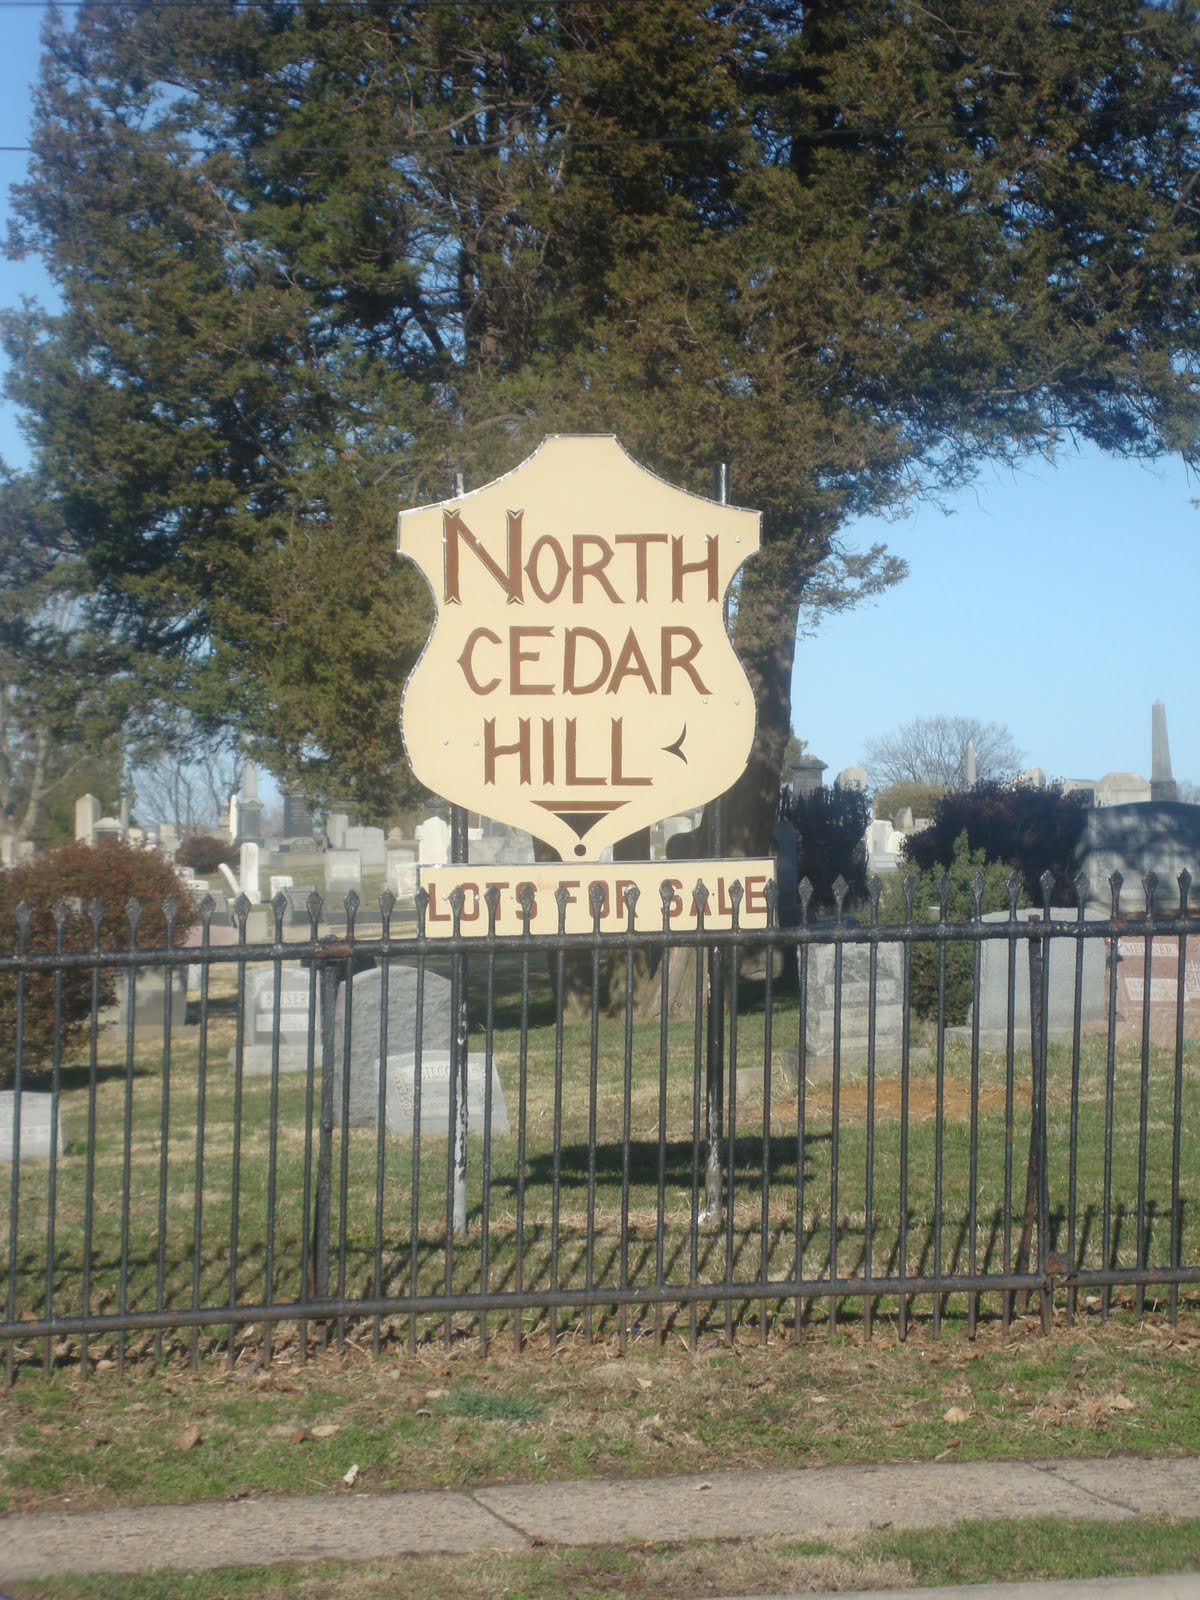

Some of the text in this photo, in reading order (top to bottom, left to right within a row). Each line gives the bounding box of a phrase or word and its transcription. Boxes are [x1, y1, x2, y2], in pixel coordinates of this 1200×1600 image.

[442, 508, 719, 606] NORTH
[456, 625, 713, 696] CEDAR
[483, 716, 654, 786] HILL
[428, 875, 768, 922] LOTS FOR SALE
